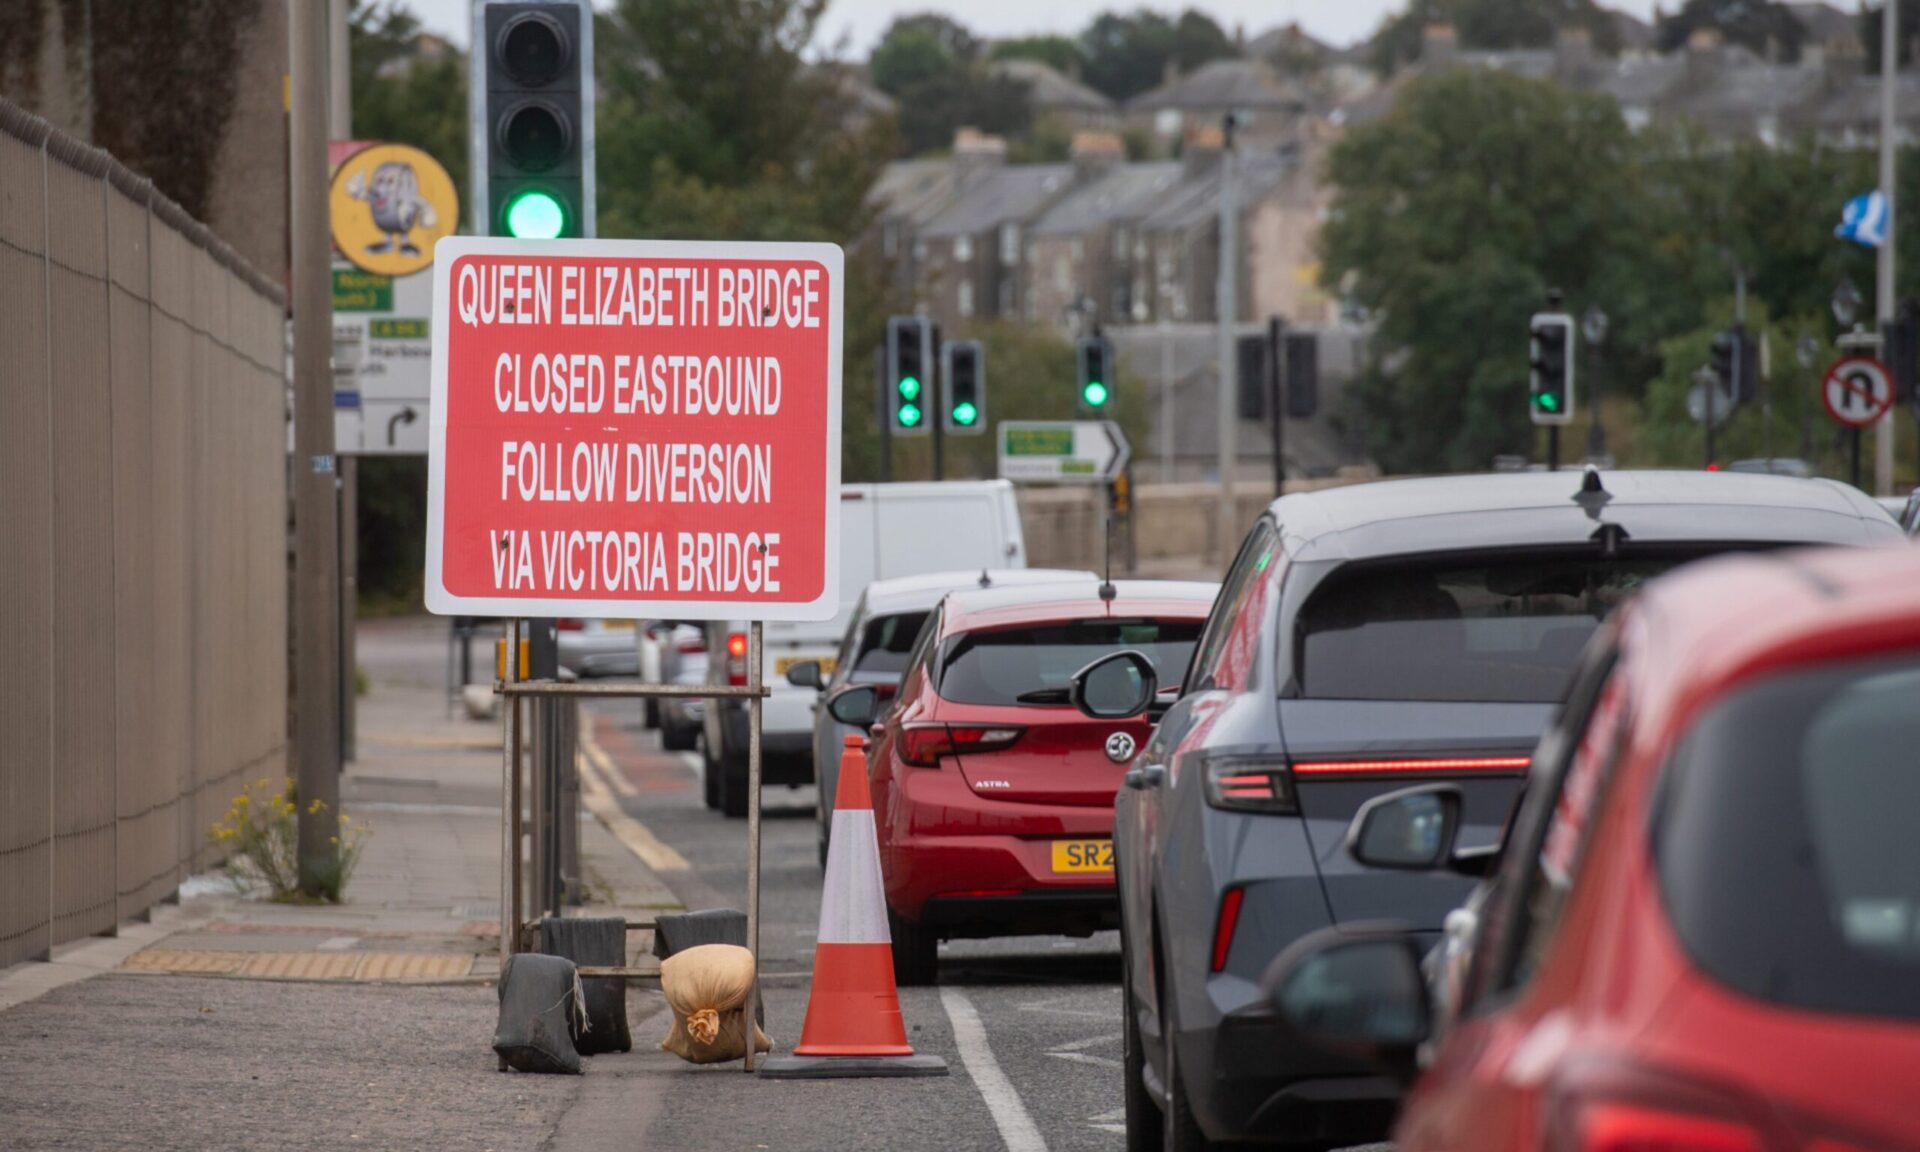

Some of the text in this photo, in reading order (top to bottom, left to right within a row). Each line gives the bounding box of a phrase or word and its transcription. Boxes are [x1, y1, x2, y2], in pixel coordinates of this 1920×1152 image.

[458, 264, 819, 328] QUEEN ELIZABETH BRIDGE
[495, 353, 781, 415] CLOSED EASTBOUND
[502, 441, 771, 504] FOLLOW DIVERSION
[491, 530, 780, 592] VIA VICTORIA BRIDGE
[976, 780, 1010, 788] ASTRA
